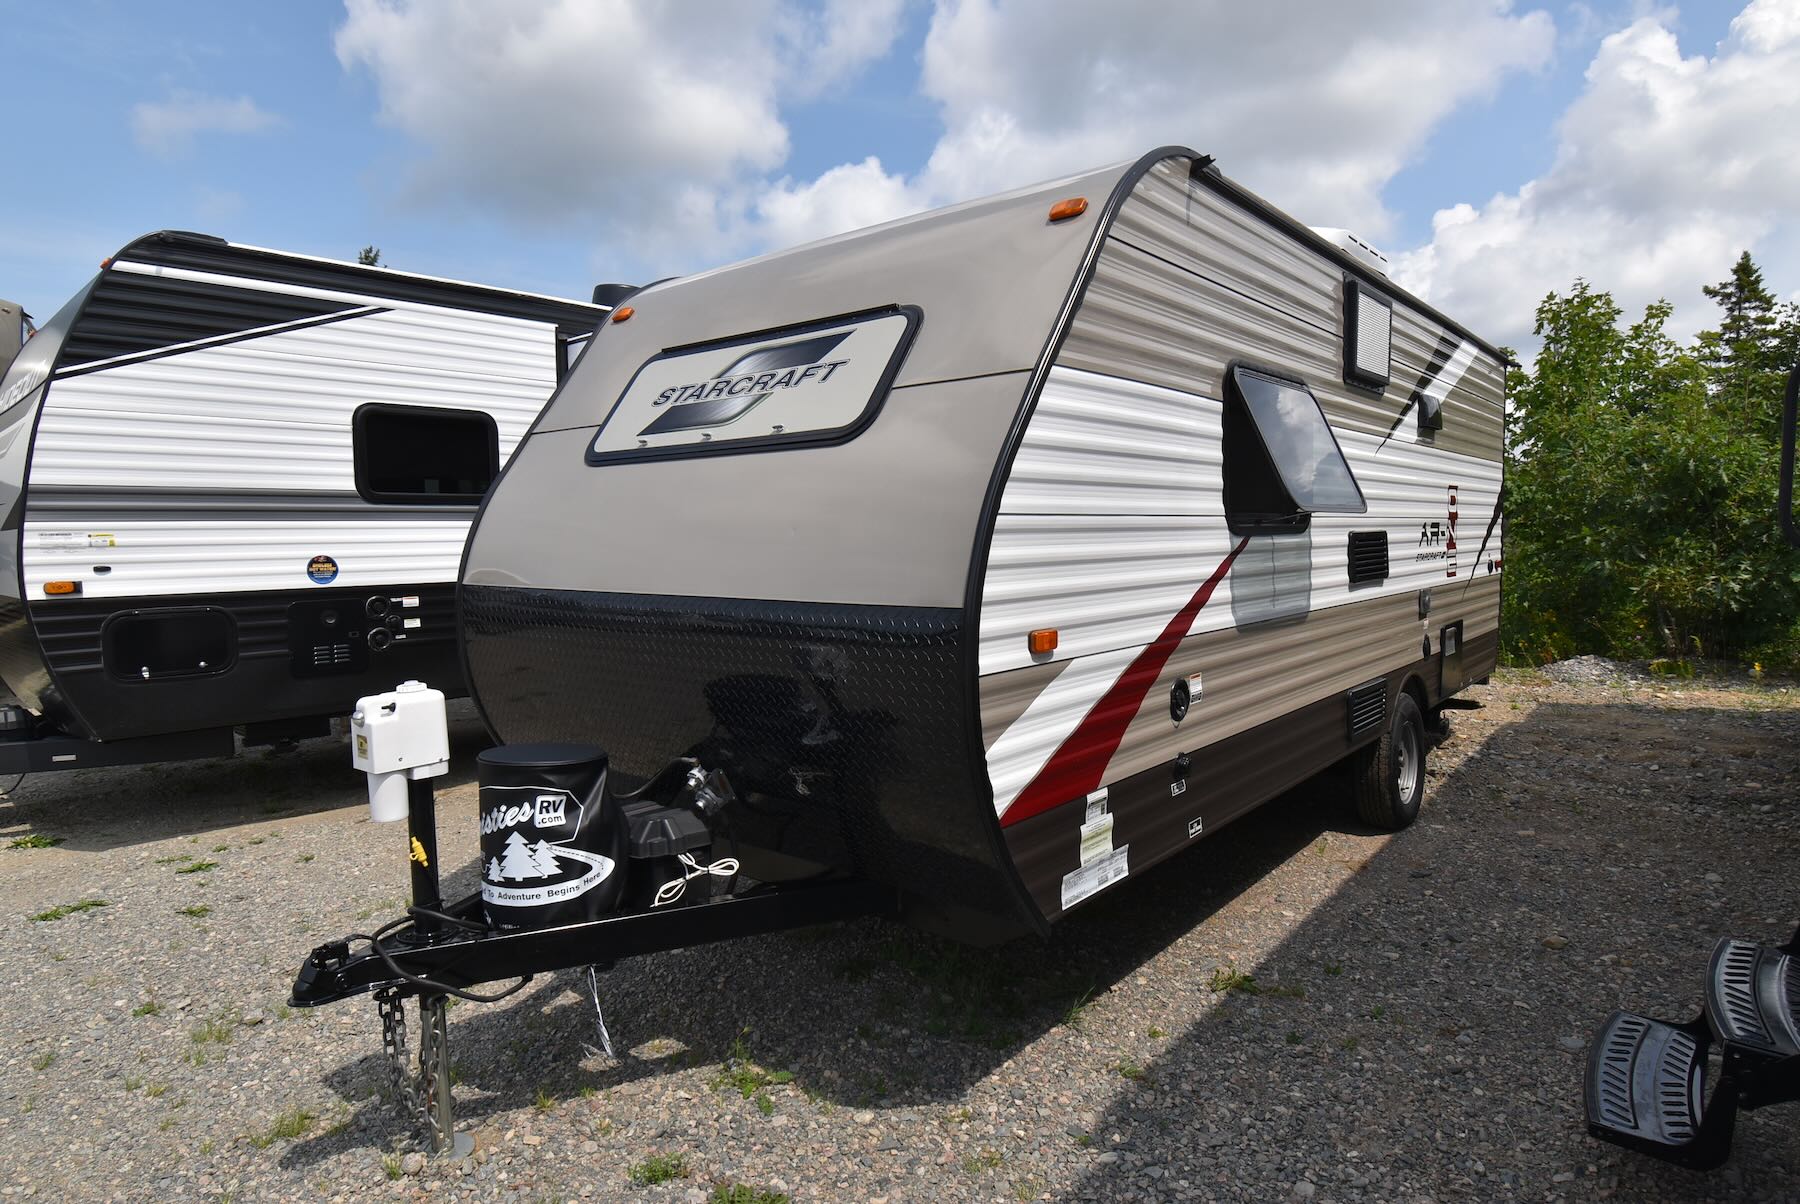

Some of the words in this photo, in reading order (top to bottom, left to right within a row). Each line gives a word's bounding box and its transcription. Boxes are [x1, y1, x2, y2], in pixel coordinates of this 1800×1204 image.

[652, 359, 849, 406] STARCRAFT
[539, 799, 564, 814] RV
[538, 815, 563, 825] .com
[487, 889, 495, 898] To
[497, 891, 541, 901] Adventure
[547, 885, 580, 898] Begins
[583, 871, 601, 887] Here
